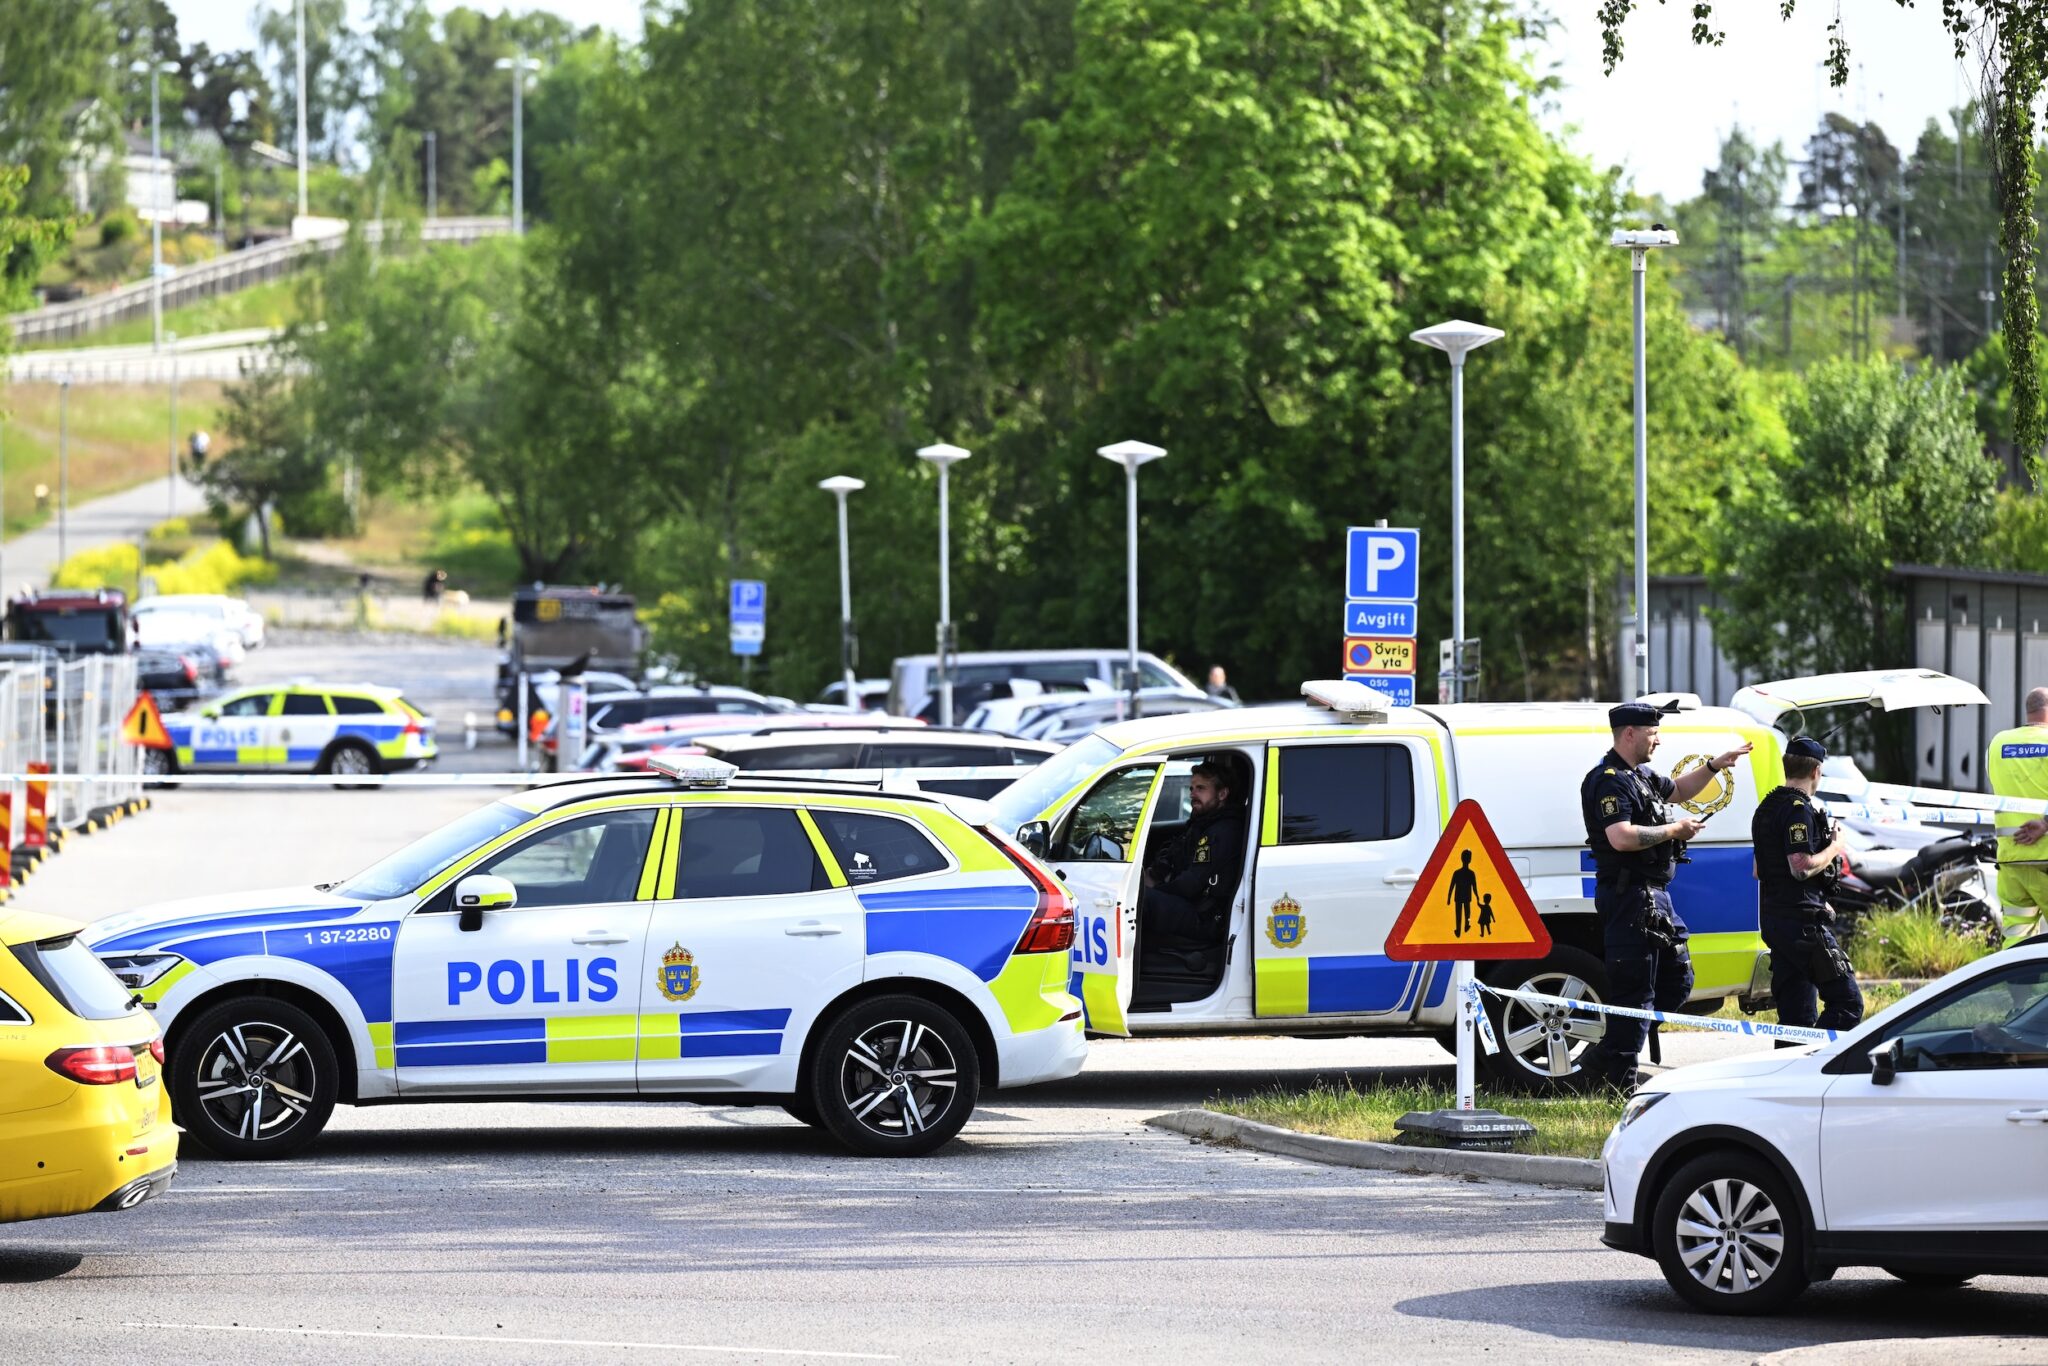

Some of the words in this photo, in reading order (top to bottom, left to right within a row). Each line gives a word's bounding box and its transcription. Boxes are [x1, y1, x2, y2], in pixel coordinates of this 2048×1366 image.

[1366, 536, 1405, 592] P
[741, 583, 759, 608] P
[1356, 611, 1406, 629] Avgift
[1374, 642, 1409, 657] Övrig
[1382, 657, 1402, 668] yta
[1397, 688, 1410, 697] AB
[304, 932, 313, 945] 1
[320, 926, 391, 944] 37-2280
[447, 957, 618, 1005] POLIS
[1755, 1023, 1784, 1036] POLIS
[1462, 1124, 1491, 1132] ROAD
